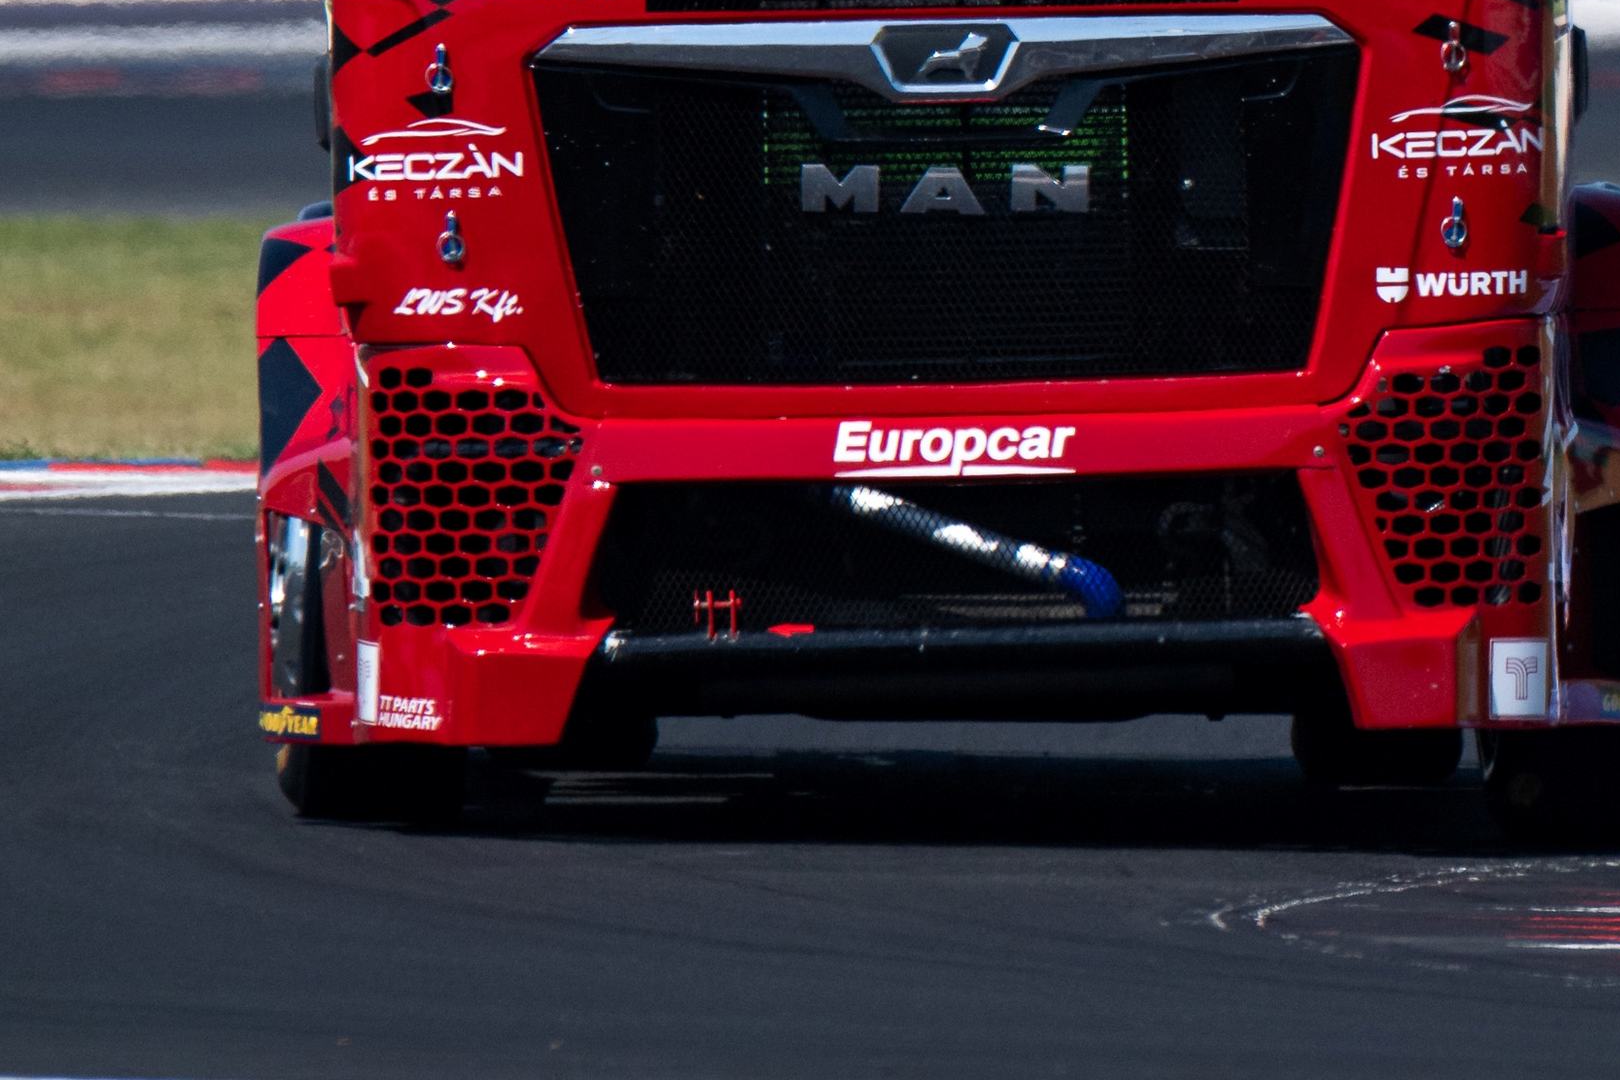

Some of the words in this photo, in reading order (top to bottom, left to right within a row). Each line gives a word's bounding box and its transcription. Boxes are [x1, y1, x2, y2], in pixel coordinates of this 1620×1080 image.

[1398, 164, 1428, 179] ÉS
[1446, 161, 1528, 177] TÁRSA
[801, 163, 1090, 216] MAN
[1416, 269, 1528, 297] WÜRTH
[833, 420, 1077, 476] Europcar
[393, 696, 436, 716] PARTS
[378, 712, 442, 731] HUNGARY
